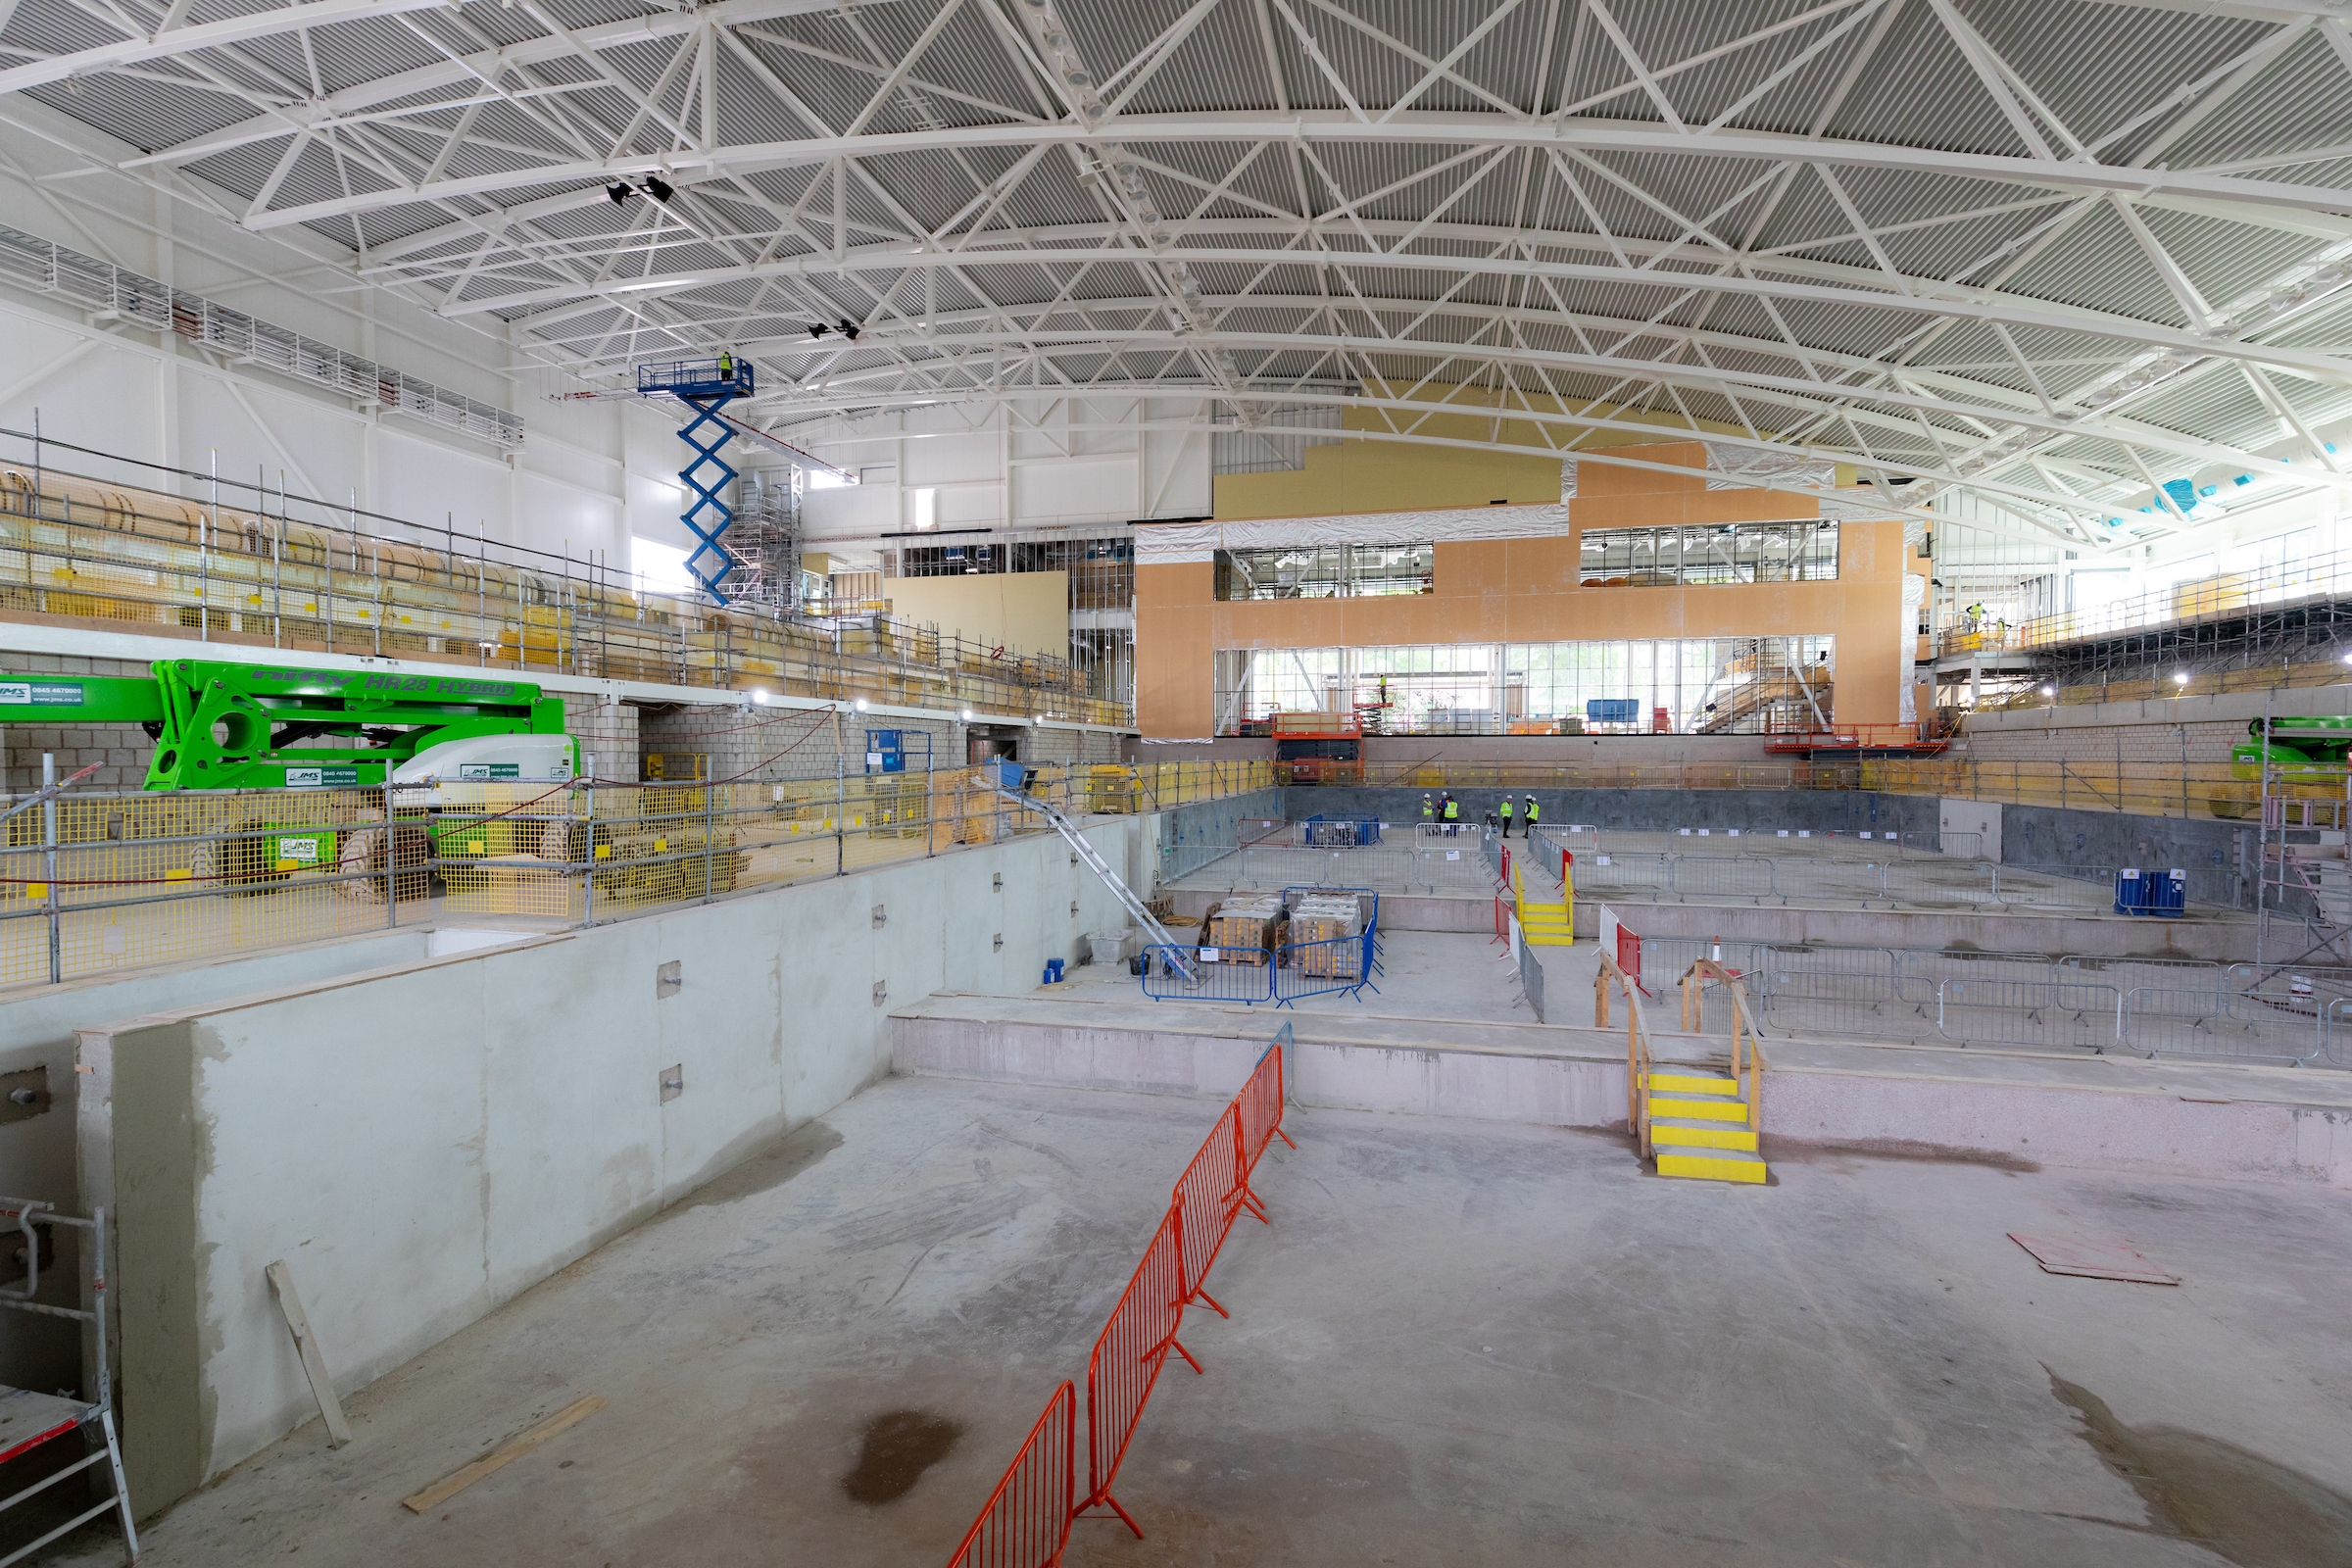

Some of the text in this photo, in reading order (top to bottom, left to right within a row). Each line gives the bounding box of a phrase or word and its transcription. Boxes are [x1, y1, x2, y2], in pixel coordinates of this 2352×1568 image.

[251, 670, 515, 697] nifty HR28 HYBRID
